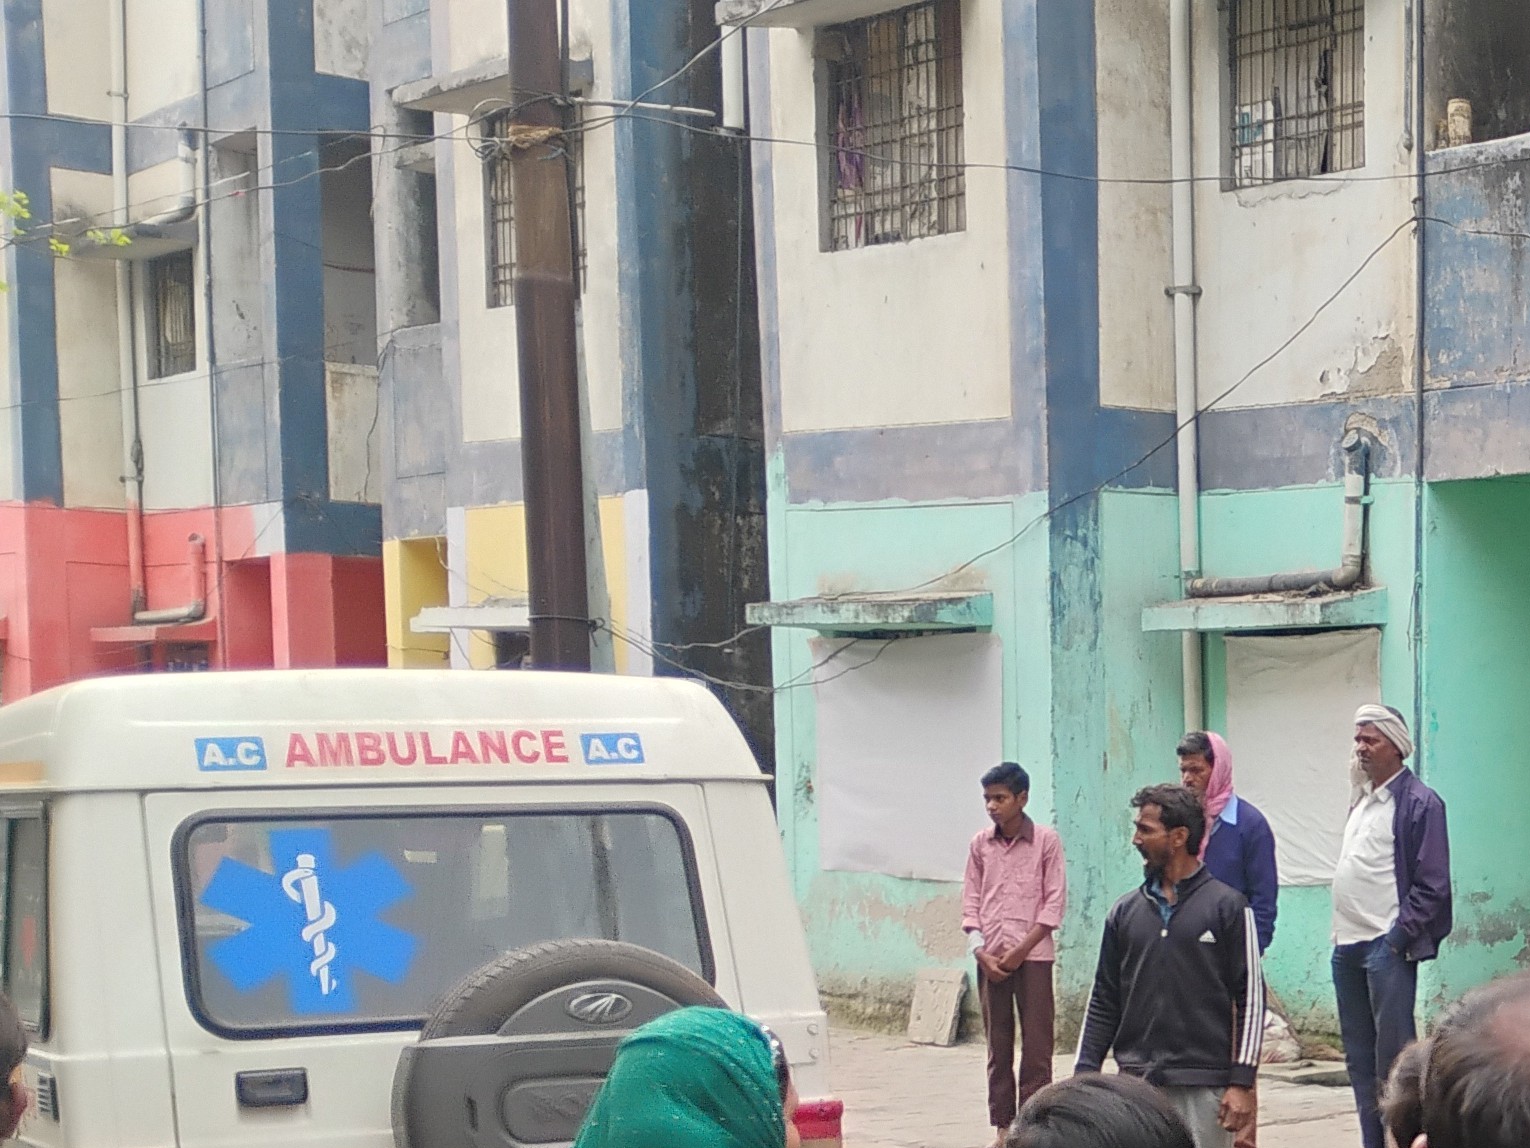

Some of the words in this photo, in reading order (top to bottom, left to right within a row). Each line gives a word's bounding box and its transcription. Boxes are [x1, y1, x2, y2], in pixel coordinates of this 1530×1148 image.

[203, 742, 262, 767] A.C
[285, 729, 570, 768] AMBULANCE
[588, 737, 641, 760] A.C
